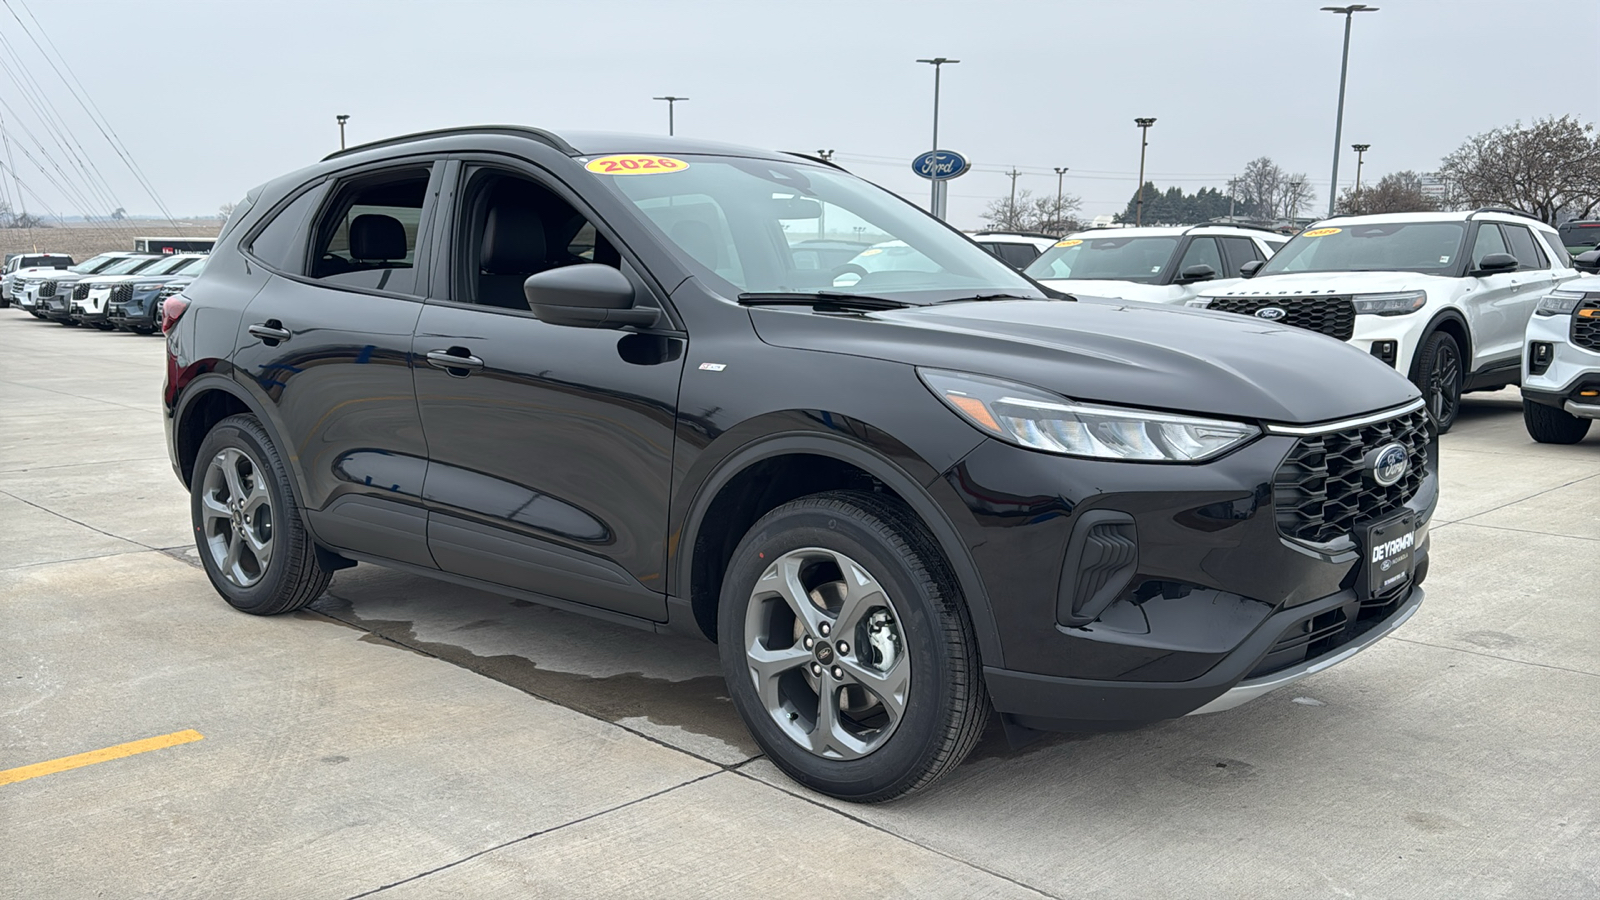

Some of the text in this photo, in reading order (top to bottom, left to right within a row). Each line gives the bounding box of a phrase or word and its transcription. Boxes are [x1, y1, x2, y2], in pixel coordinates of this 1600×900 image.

[599, 158, 679, 173] 2026
[921, 155, 954, 174] Frd
[1261, 310, 1279, 318] Ford
[1384, 449, 1404, 477] Ford
[1372, 530, 1415, 563] DEYARMAN
